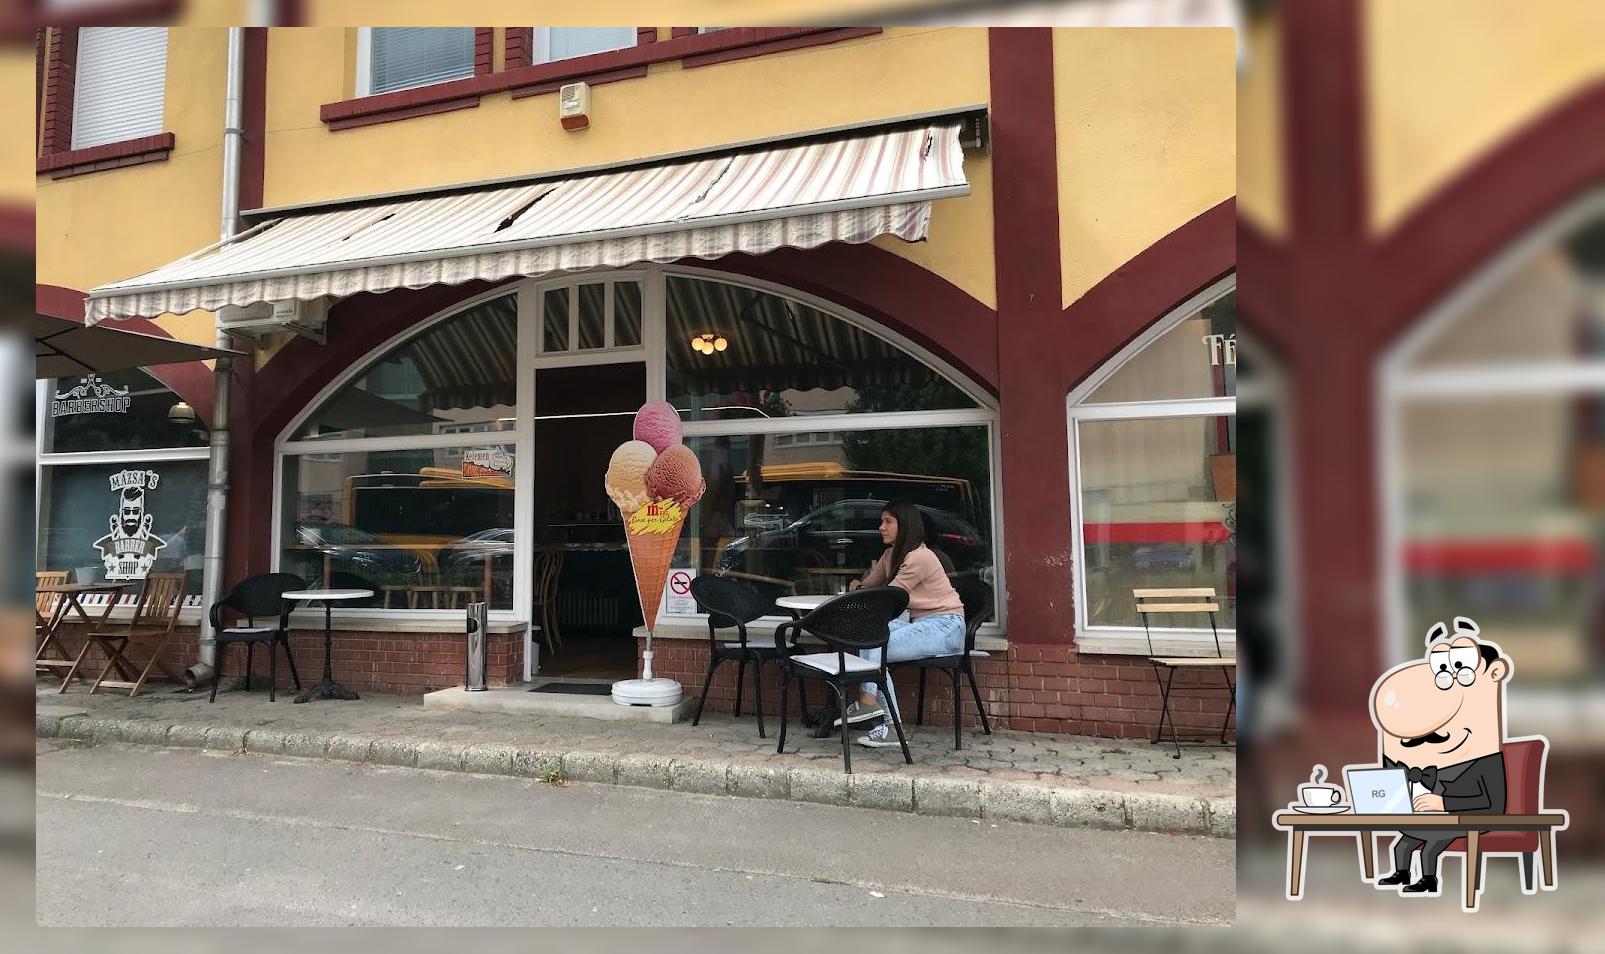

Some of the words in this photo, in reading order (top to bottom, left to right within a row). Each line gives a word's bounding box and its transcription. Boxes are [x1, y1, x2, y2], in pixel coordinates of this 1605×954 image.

[51, 397, 131, 418] BARBERSHOP
[115, 539, 146, 555] BARBER
[119, 561, 139, 575] SHOP
